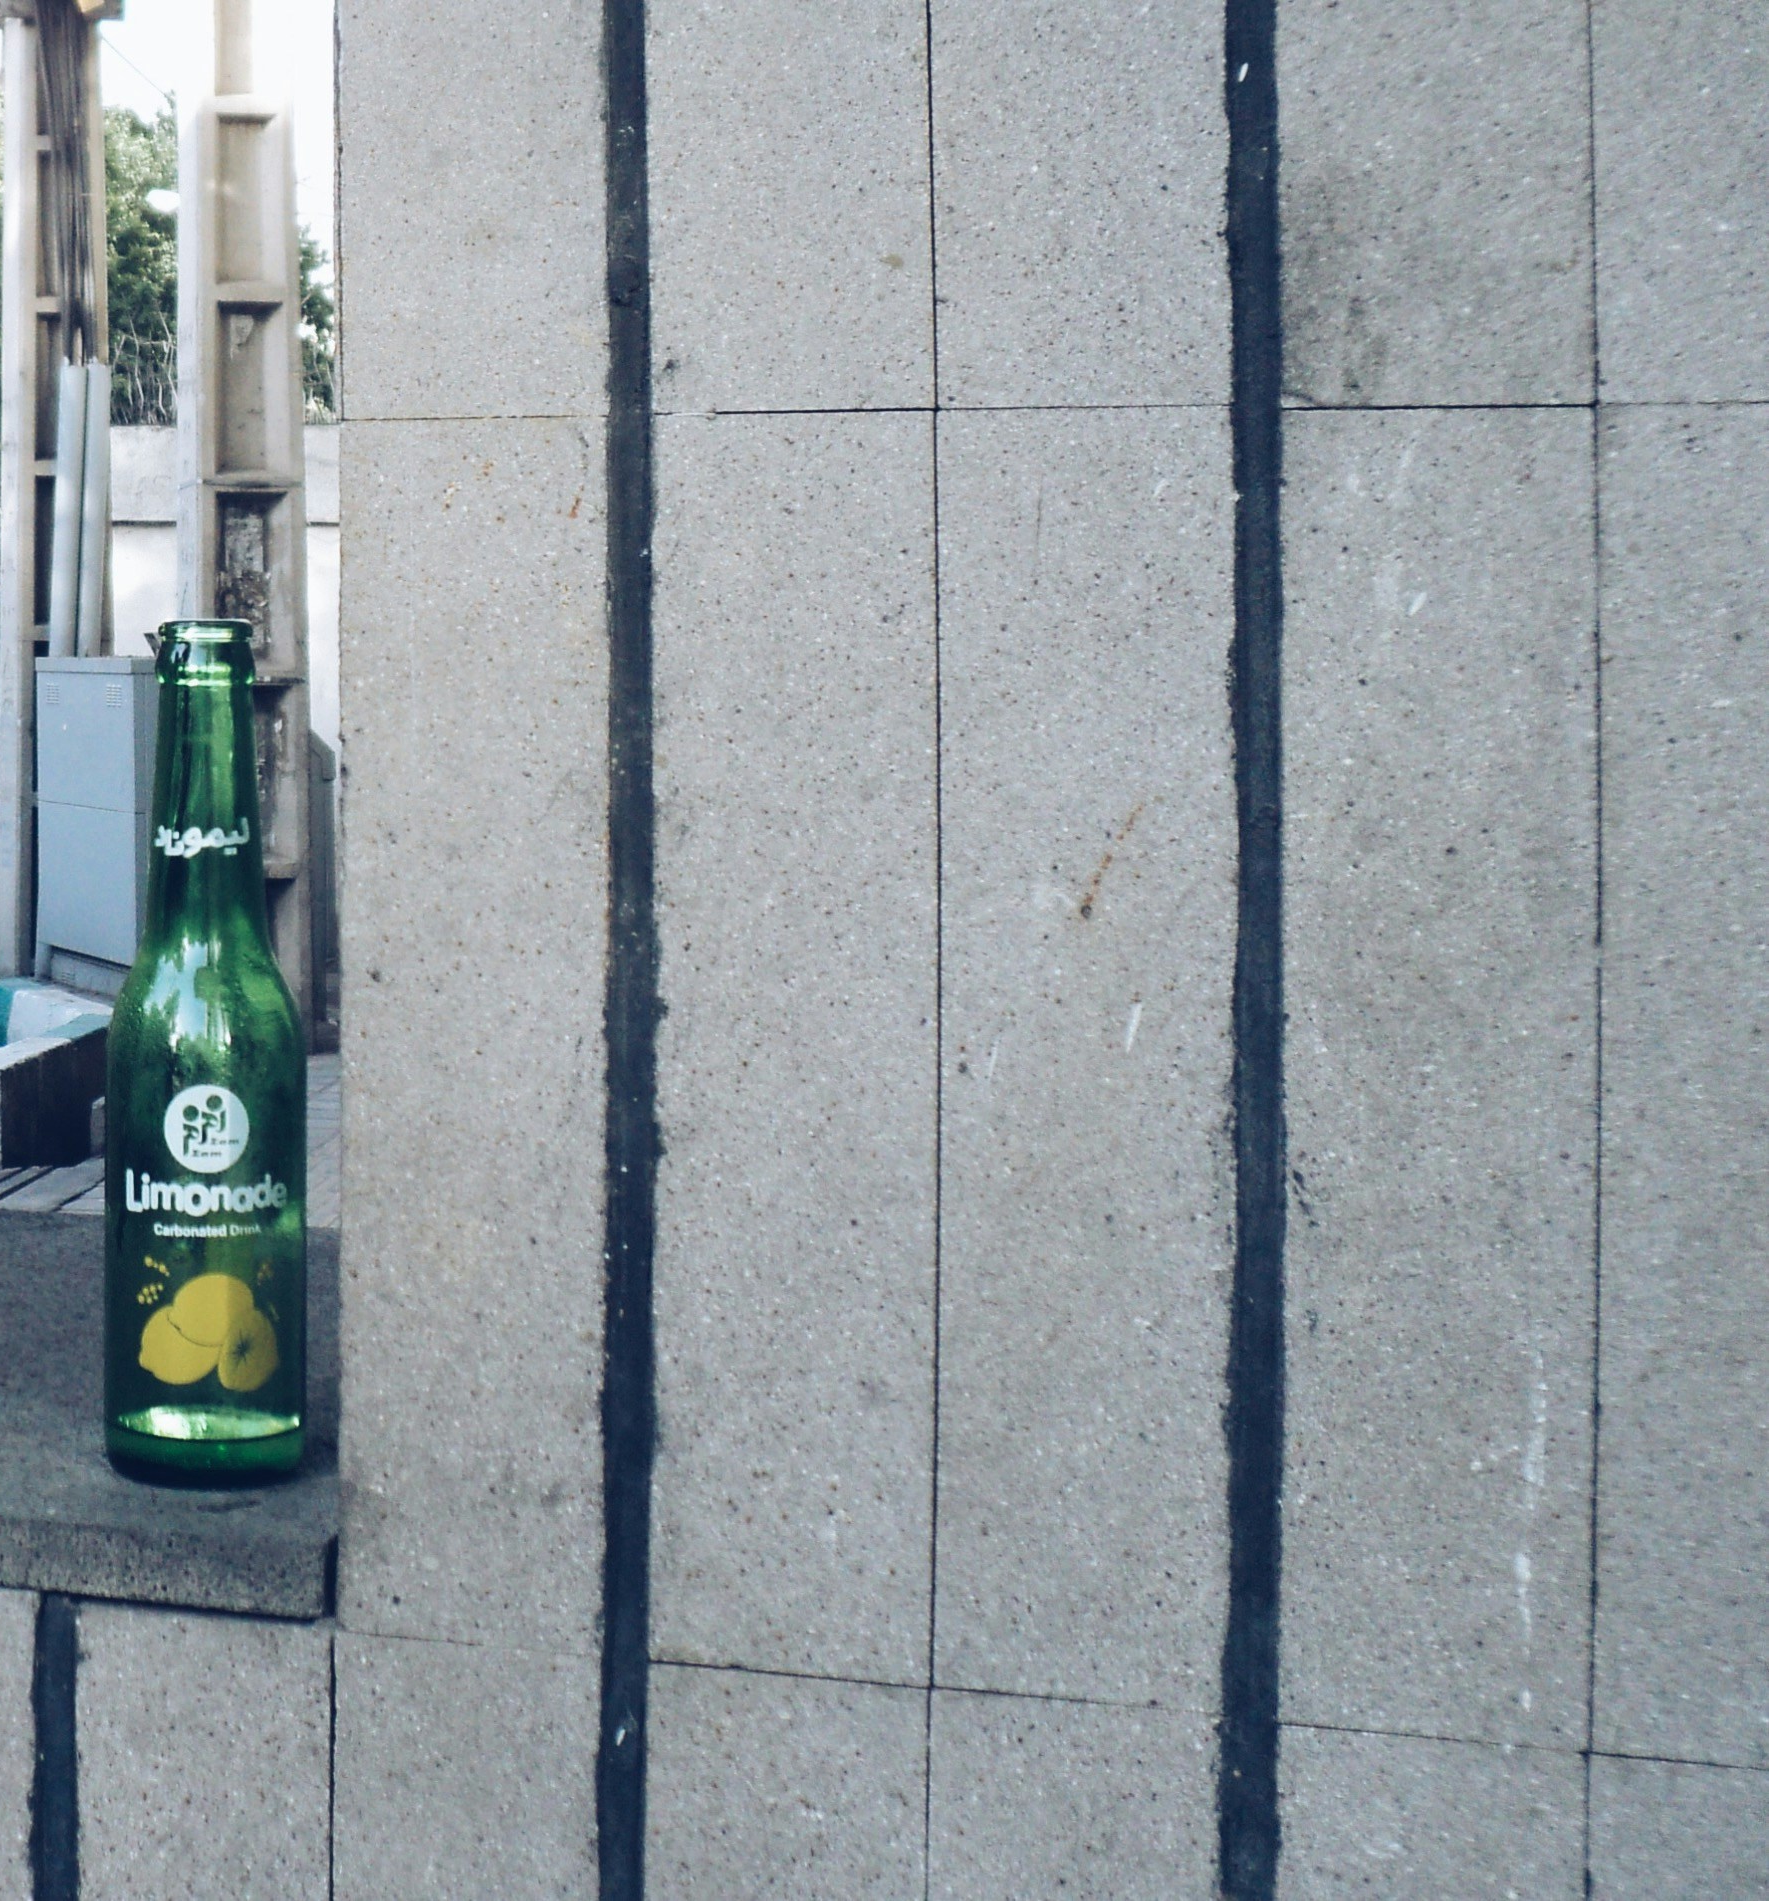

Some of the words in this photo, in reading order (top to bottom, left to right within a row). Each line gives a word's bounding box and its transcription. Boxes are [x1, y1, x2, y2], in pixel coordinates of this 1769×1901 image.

[154, 816, 250, 858] لیموناد
[126, 1168, 288, 1217] Limonade
[153, 1221, 227, 1238] Carbonated
[229, 1222, 262, 1237] Drink
